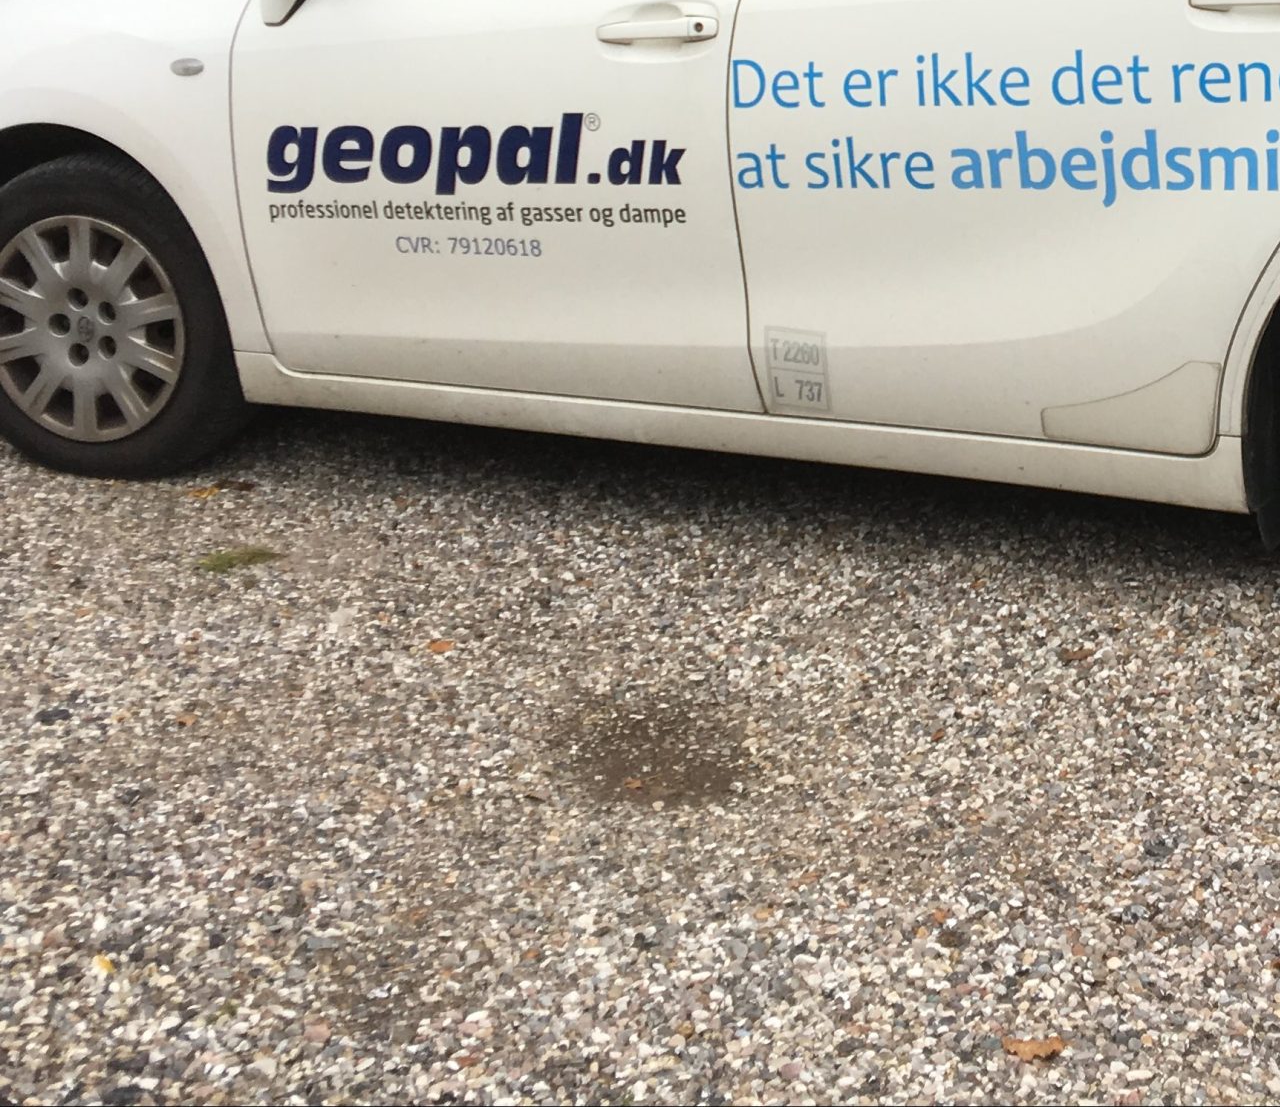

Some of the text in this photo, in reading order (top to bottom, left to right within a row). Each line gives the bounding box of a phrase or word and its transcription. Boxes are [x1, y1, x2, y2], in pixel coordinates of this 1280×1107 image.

[731, 59, 824, 110] Det
[842, 68, 899, 109] er
[915, 52, 1031, 108] ikke
[1051, 49, 1150, 108] det
[736, 142, 786, 190] at
[804, 136, 935, 191] sikre
[269, 199, 687, 227] professionel detektering af gasser og dampe
[396, 236, 543, 258] CVR: 79120618
[771, 338, 779, 361] T
[774, 376, 823, 403] L 737
